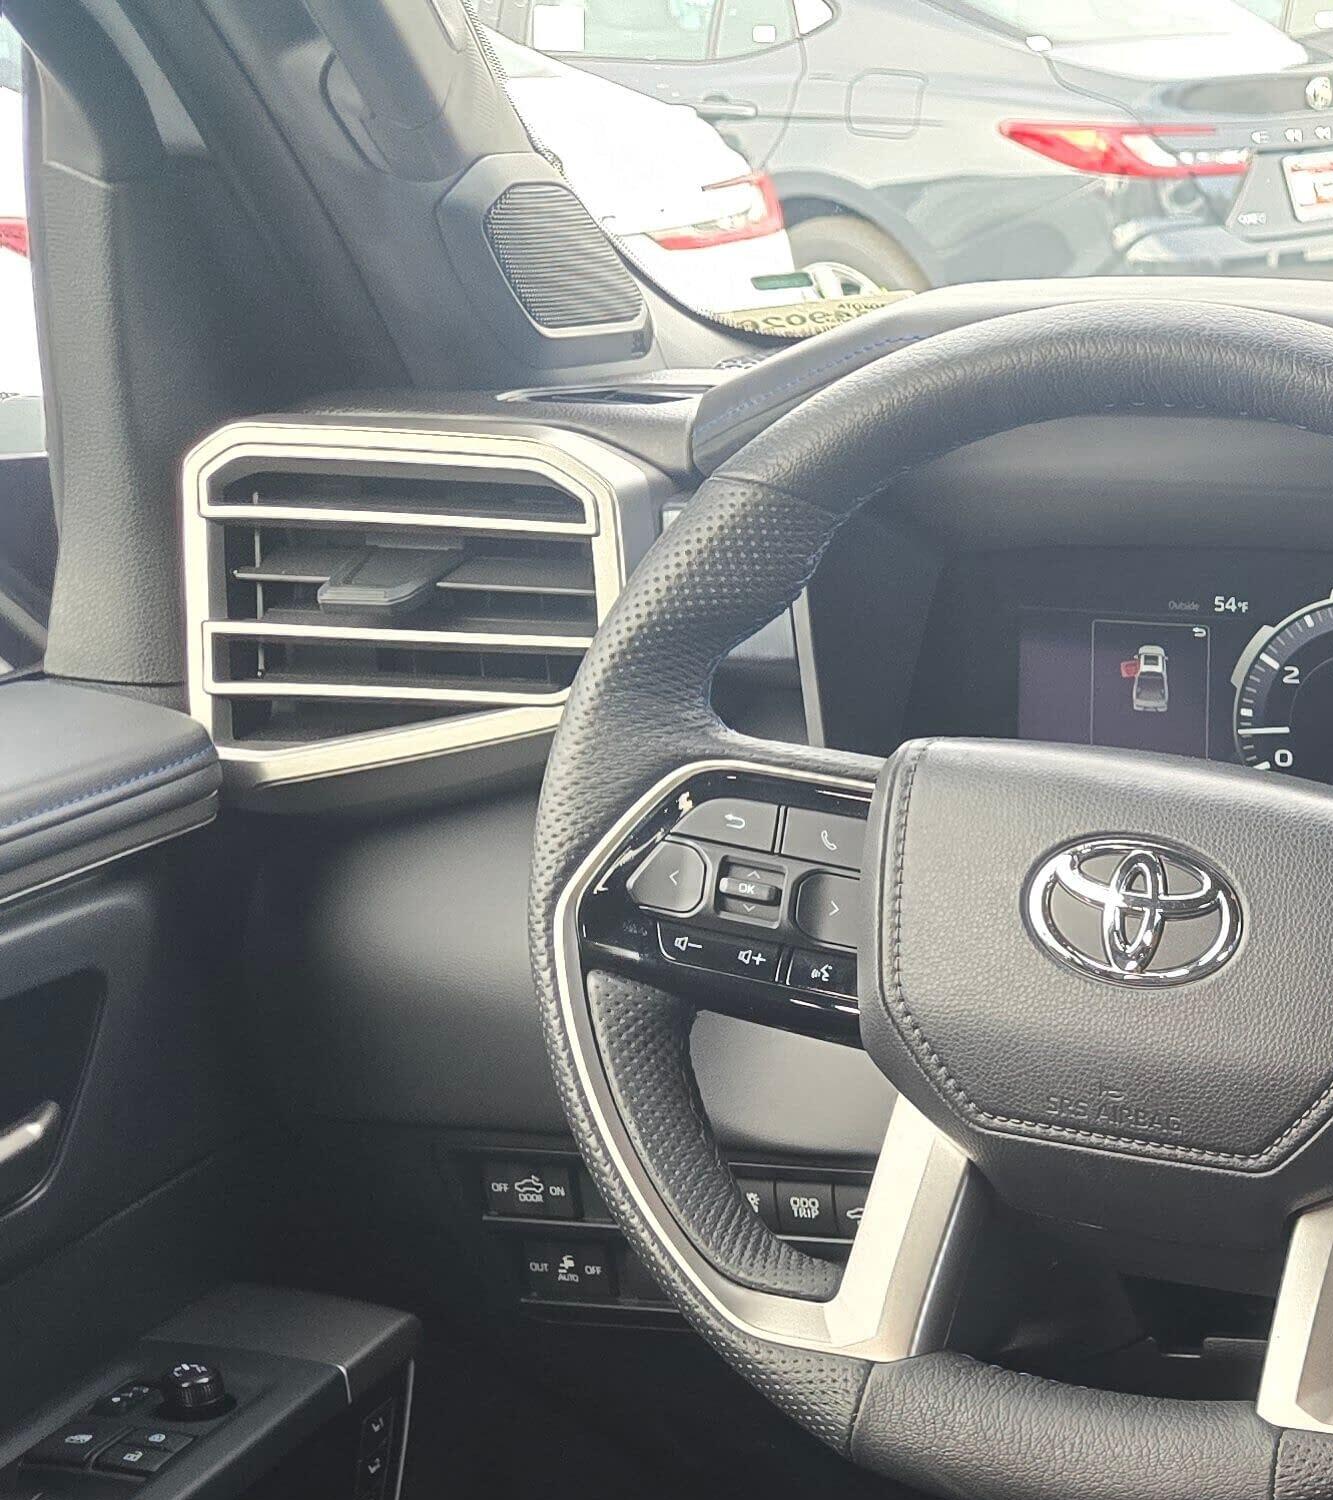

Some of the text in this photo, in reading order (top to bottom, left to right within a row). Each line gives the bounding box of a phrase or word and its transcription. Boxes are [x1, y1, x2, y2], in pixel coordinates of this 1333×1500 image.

[1283, 666, 1300, 684] 2
[1274, 749, 1293, 767] 0
[738, 882, 755, 894] OK
[492, 1182, 566, 1196] OFF ON
[518, 1193, 544, 1203] DOOR
[790, 1197, 819, 1210] ODO
[791, 1207, 819, 1220] TRIP
[529, 1261, 602, 1275] OUT OFF
[557, 1272, 579, 1283] AUTO
